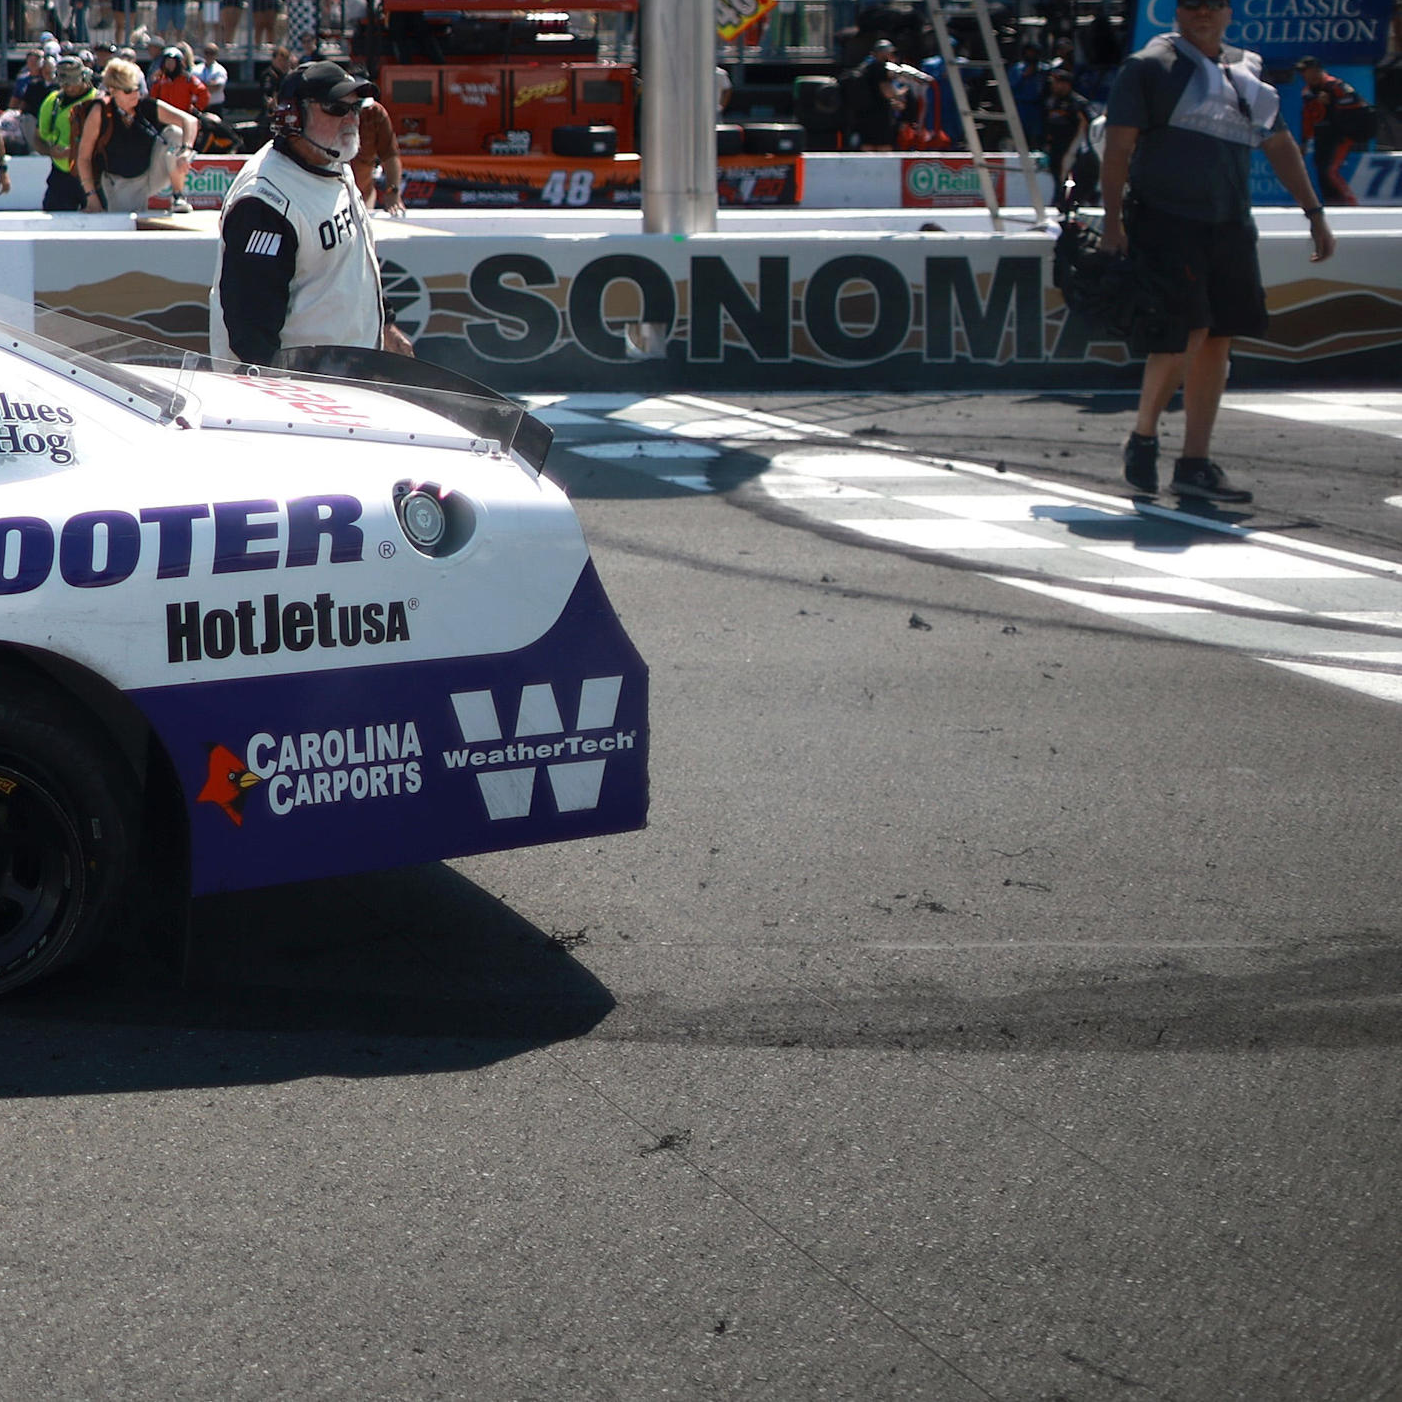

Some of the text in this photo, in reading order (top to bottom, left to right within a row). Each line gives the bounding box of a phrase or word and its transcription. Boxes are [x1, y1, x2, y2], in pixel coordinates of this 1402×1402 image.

[1221, 19, 1379, 44] COLLISION
[541, 170, 594, 206] 48
[913, 166, 982, 193] O'Reill
[246, 721, 422, 780] CAROLINA
[442, 728, 636, 769] WeatherTech
[267, 762, 422, 816] CARPORTS
